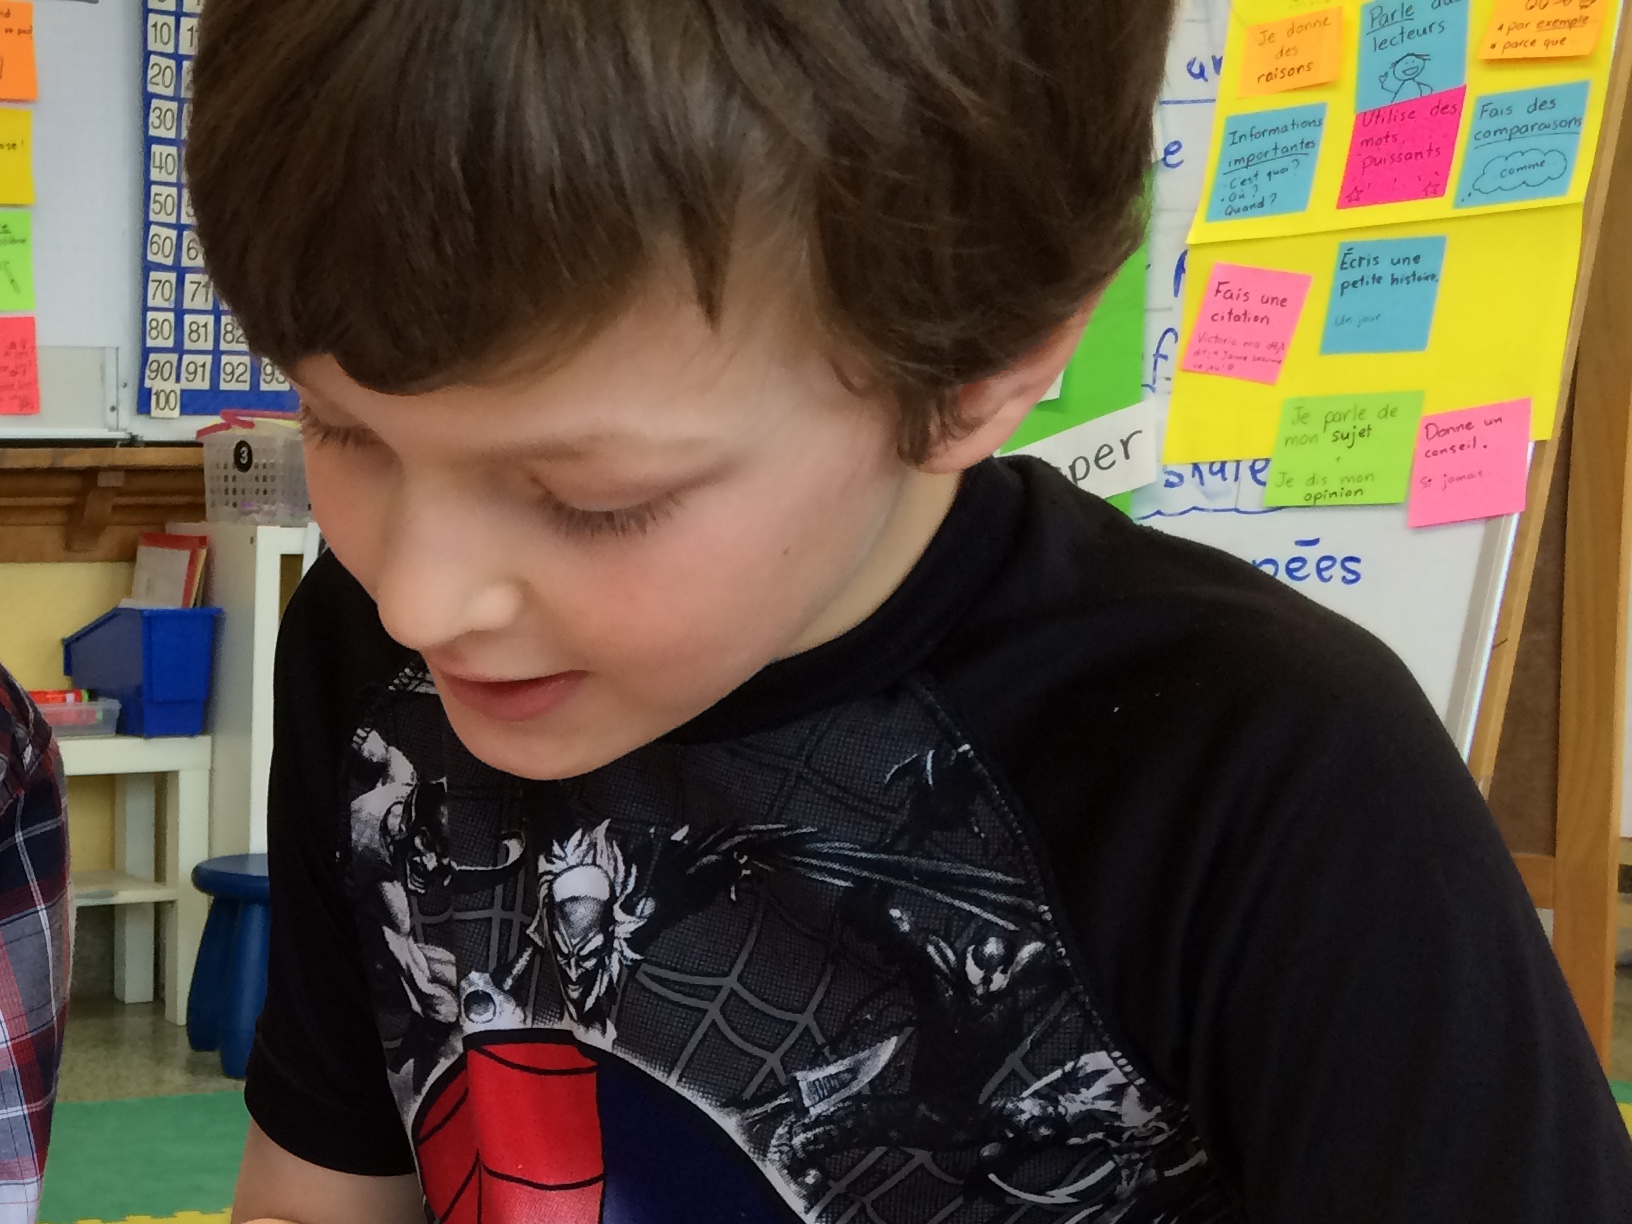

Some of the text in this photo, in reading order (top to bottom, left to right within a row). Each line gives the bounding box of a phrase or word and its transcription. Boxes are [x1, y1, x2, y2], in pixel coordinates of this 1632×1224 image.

[1369, 3, 1414, 29] Parle
[1506, 14, 1590, 36] par exemple
[150, 21, 172, 46] 10
[1258, 15, 1332, 46] Je donne
[1372, 18, 1446, 52] lecteurs
[1275, 45, 1299, 60] des
[1502, 36, 1567, 54] parce que
[149, 62, 174, 89] 20
[1257, 61, 1314, 85] raisons
[151, 106, 175, 132] 30
[1361, 100, 1458, 129] Utilise des
[1479, 96, 1557, 120] Fais des
[1228, 116, 1324, 147] Informations
[1473, 115, 1583, 142] comparaisons
[152, 151, 176, 177] 40
[1227, 138, 1317, 169] importantes
[1361, 145, 1441, 177] puissants
[1229, 171, 1259, 190] C'est
[1499, 159, 1546, 179] comme
[151, 193, 176, 218] 50
[149, 233, 174, 259] 60
[1339, 247, 1422, 271] Écris une
[151, 279, 213, 305] 70 71
[1214, 280, 1288, 308] Fais une
[1339, 272, 1383, 297] petite
[1210, 308, 1270, 326] citation
[148, 317, 173, 341] 80
[188, 320, 210, 344] 81
[147, 359, 248, 385] 90 91 92
[152, 388, 178, 412] 100
[1290, 402, 1399, 433] Je parle de
[1424, 416, 1503, 441] Donne un
[1284, 424, 1373, 449] mon sujet
[239, 447, 248, 465] 3
[1275, 471, 1294, 489] Je
[1305, 472, 1328, 486] dis
[1340, 472, 1375, 484] mon
[1303, 486, 1364, 505] opinion
